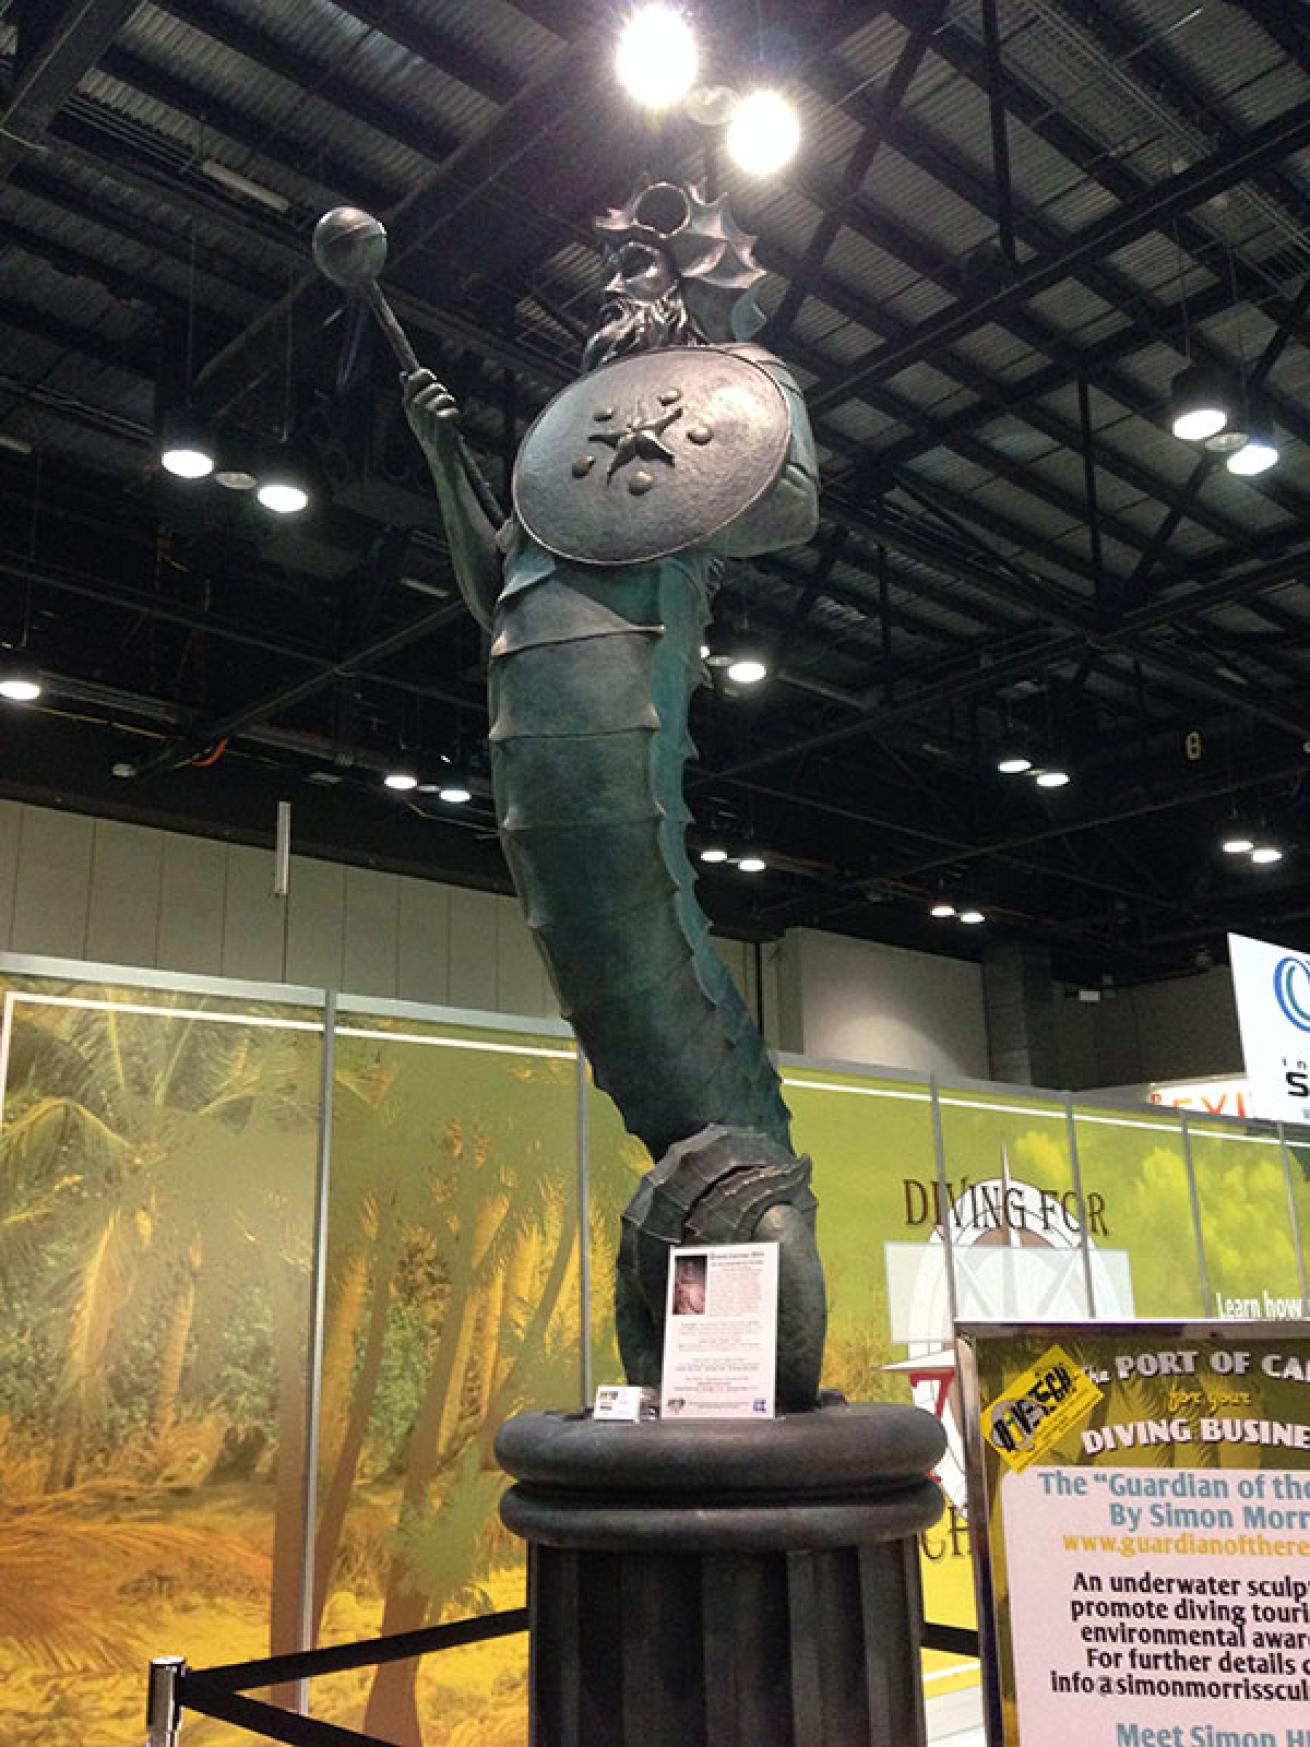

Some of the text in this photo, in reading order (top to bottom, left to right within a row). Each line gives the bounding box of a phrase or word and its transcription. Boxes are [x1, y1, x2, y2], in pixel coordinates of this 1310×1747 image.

[903, 1176, 1109, 1236] DIVING FOR
[1216, 1291, 1262, 1319] Learn
[1115, 1351, 1199, 1379] PORT
[1209, 1351, 1251, 1376] OF
[1081, 1418, 1192, 1455] DIVING
[1200, 1417, 1310, 1450] BUSINE
[1037, 1470, 1088, 1497] The
[1237, 1473, 1267, 1500] of
[1109, 1502, 1310, 1531] By Simon Morr
[1062, 1531, 1310, 1557] www.guardianofthere
[1073, 1571, 1310, 1603] An underwater sculp
[1071, 1599, 1169, 1622] promote
[1174, 1598, 1247, 1625] diving
[1081, 1622, 1310, 1650] environmental awar
[1086, 1648, 1123, 1669] For
[1129, 1648, 1213, 1672] further
[1218, 1651, 1297, 1676] details
[1116, 1722, 1184, 1747] Meet
[1190, 1724, 1277, 1747] Simon
